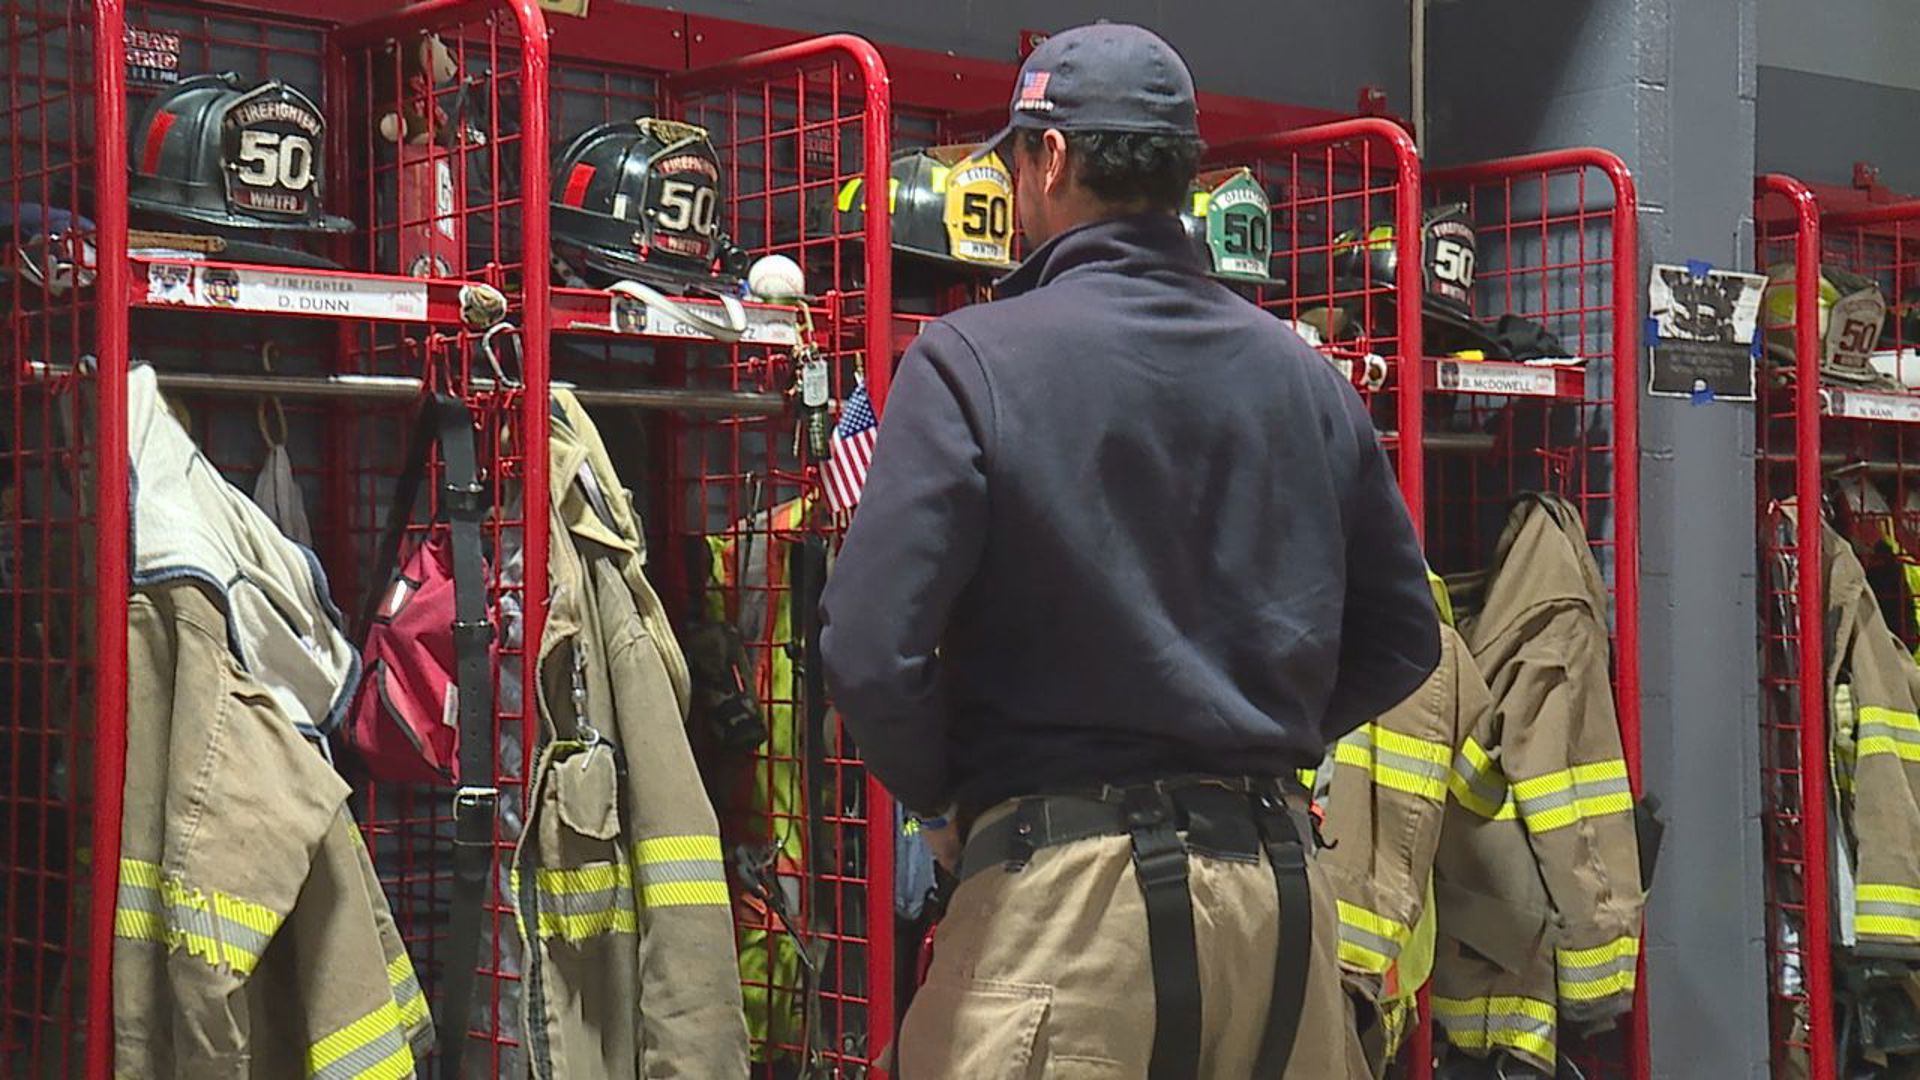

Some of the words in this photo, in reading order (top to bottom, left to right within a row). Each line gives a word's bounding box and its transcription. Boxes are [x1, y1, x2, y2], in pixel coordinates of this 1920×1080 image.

[239, 102, 321, 135] FIREFIGHTER
[240, 131, 312, 189] 50
[659, 180, 714, 236] 50
[963, 192, 1007, 238] 50
[1224, 213, 1266, 255] 50
[1435, 240, 1475, 289] 50
[279, 296, 295, 308] D.
[299, 298, 350, 312] DUNN
[1839, 319, 1877, 354] 50
